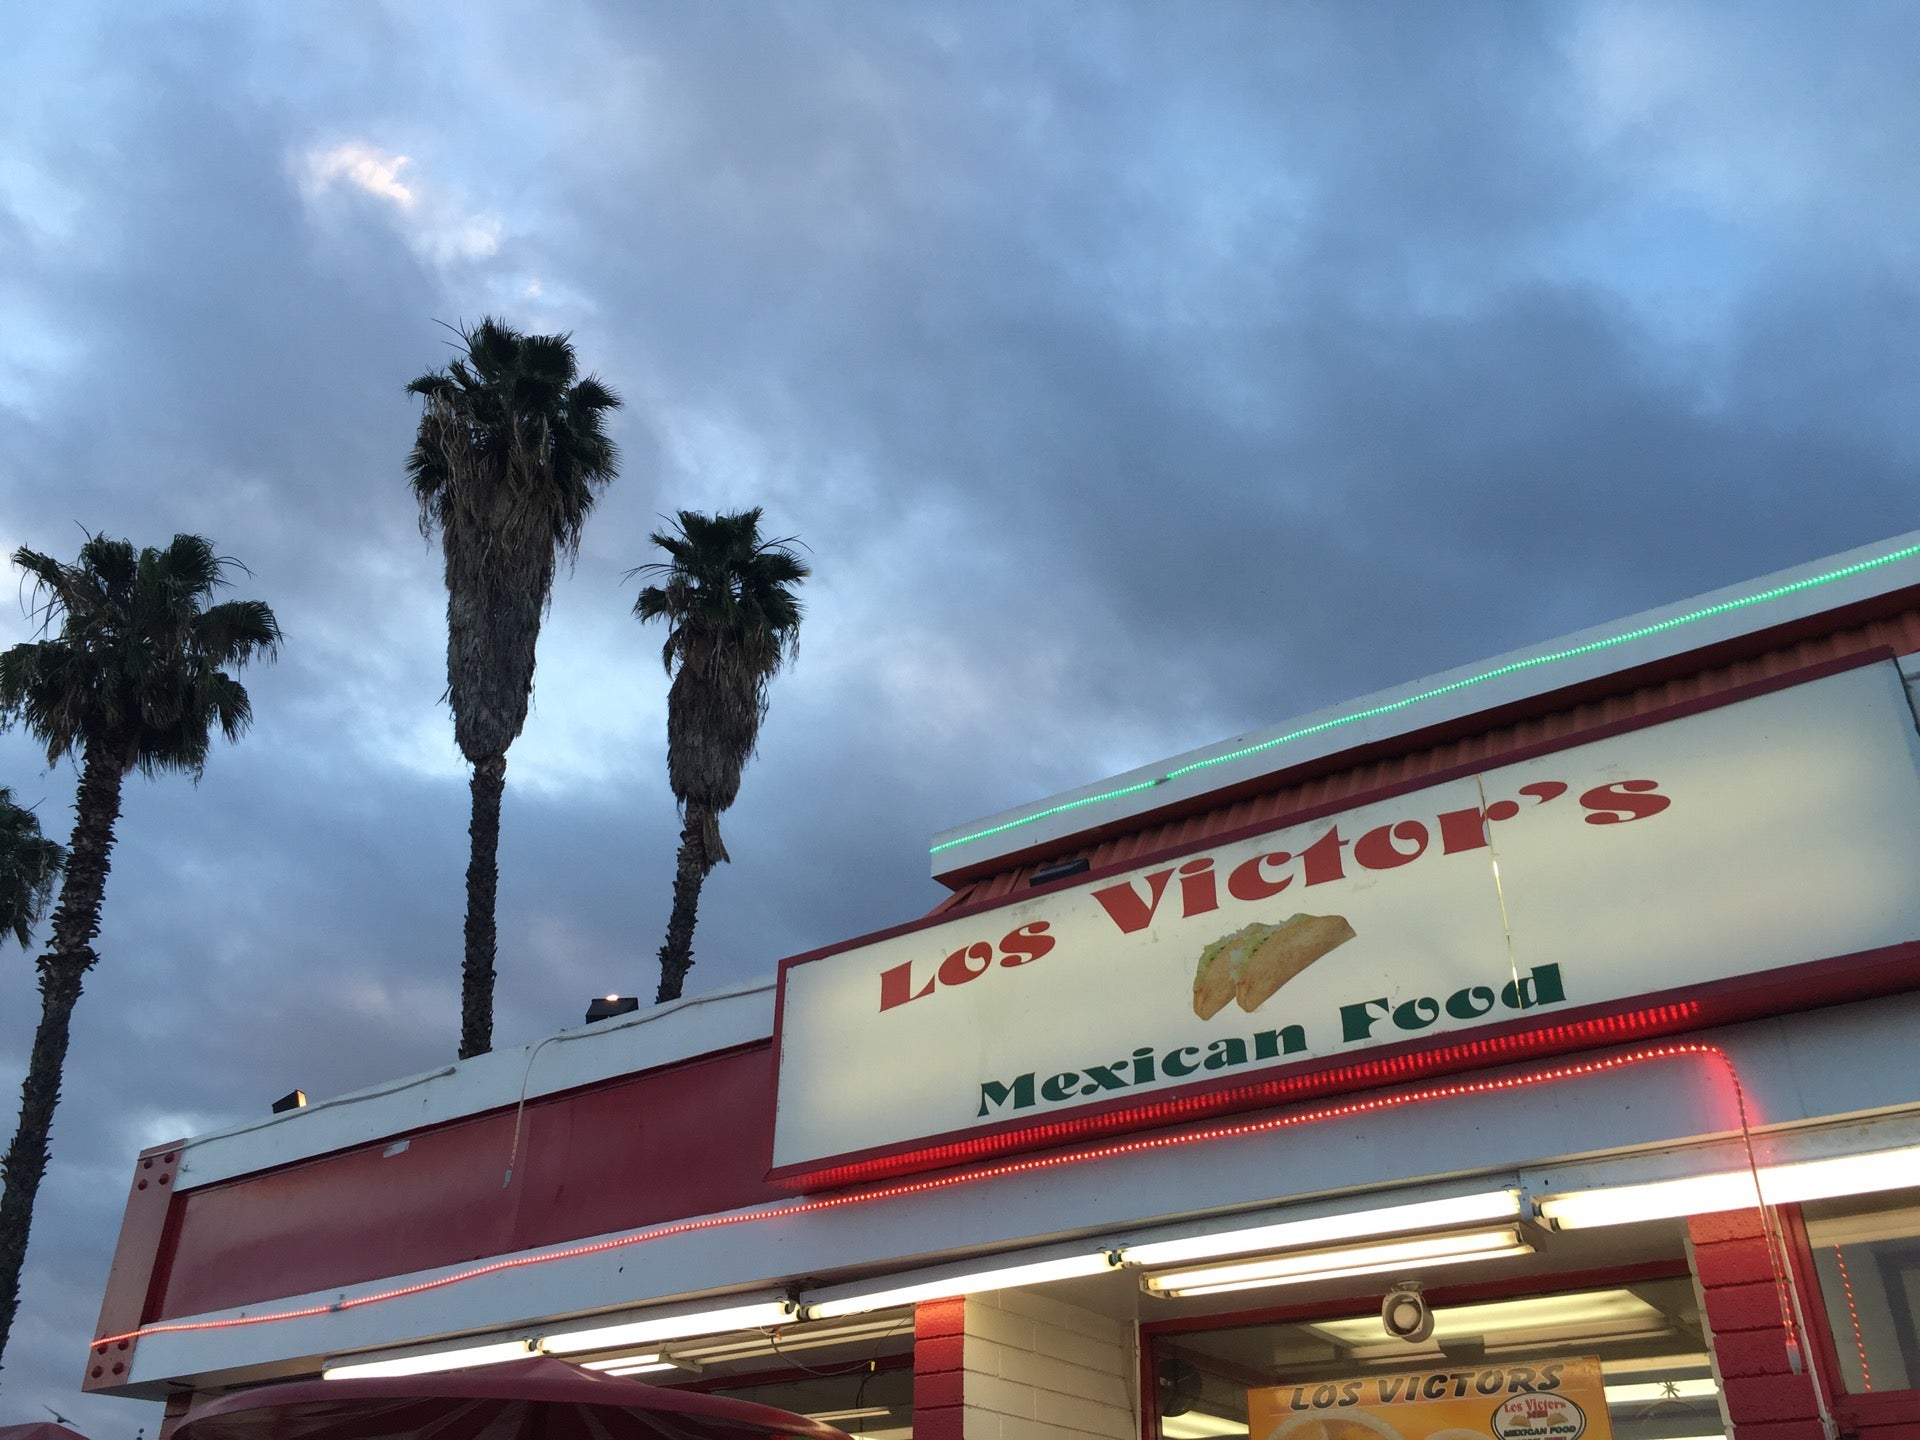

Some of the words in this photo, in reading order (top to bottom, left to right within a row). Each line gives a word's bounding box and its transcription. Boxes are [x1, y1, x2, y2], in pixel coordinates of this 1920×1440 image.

[879, 921, 1056, 1013] Los
[976, 1024, 1308, 1117] Mexican
[1339, 962, 1567, 1043] Food
[1290, 1381, 1363, 1411] LOS
[1377, 1363, 1565, 1403] VICTORS
[1549, 1424, 1577, 1434] FOOD
